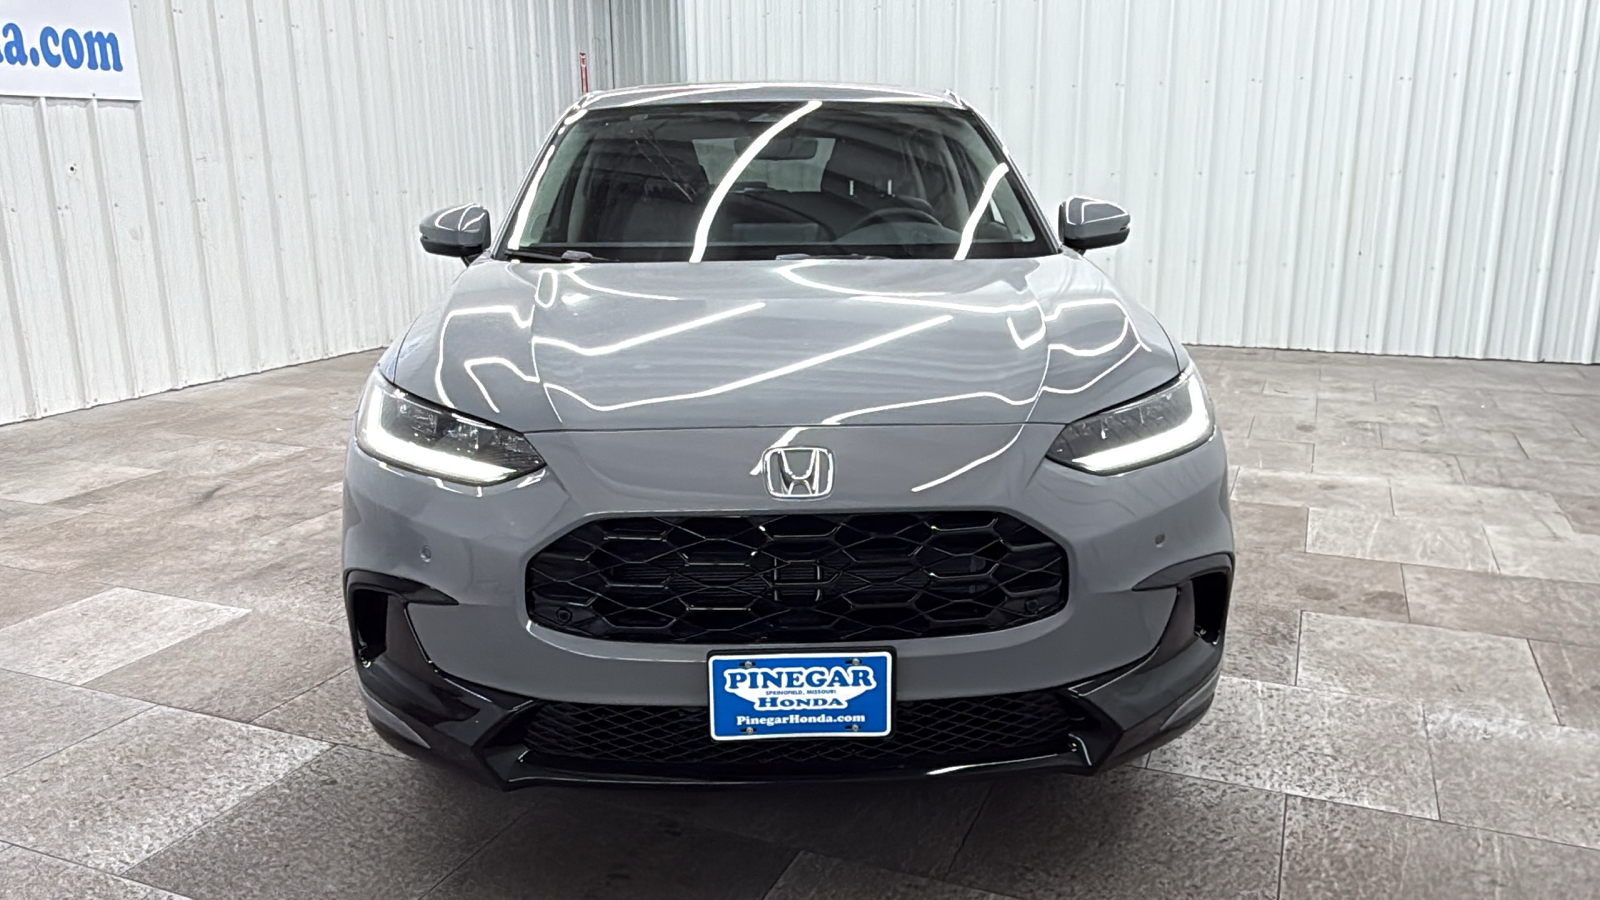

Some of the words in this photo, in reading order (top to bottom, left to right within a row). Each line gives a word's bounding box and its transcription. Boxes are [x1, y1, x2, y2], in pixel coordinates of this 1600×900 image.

[0, 22, 124, 72] a.com
[728, 669, 873, 689] PINEGAR
[736, 714, 866, 726] PinegarHonda.com
